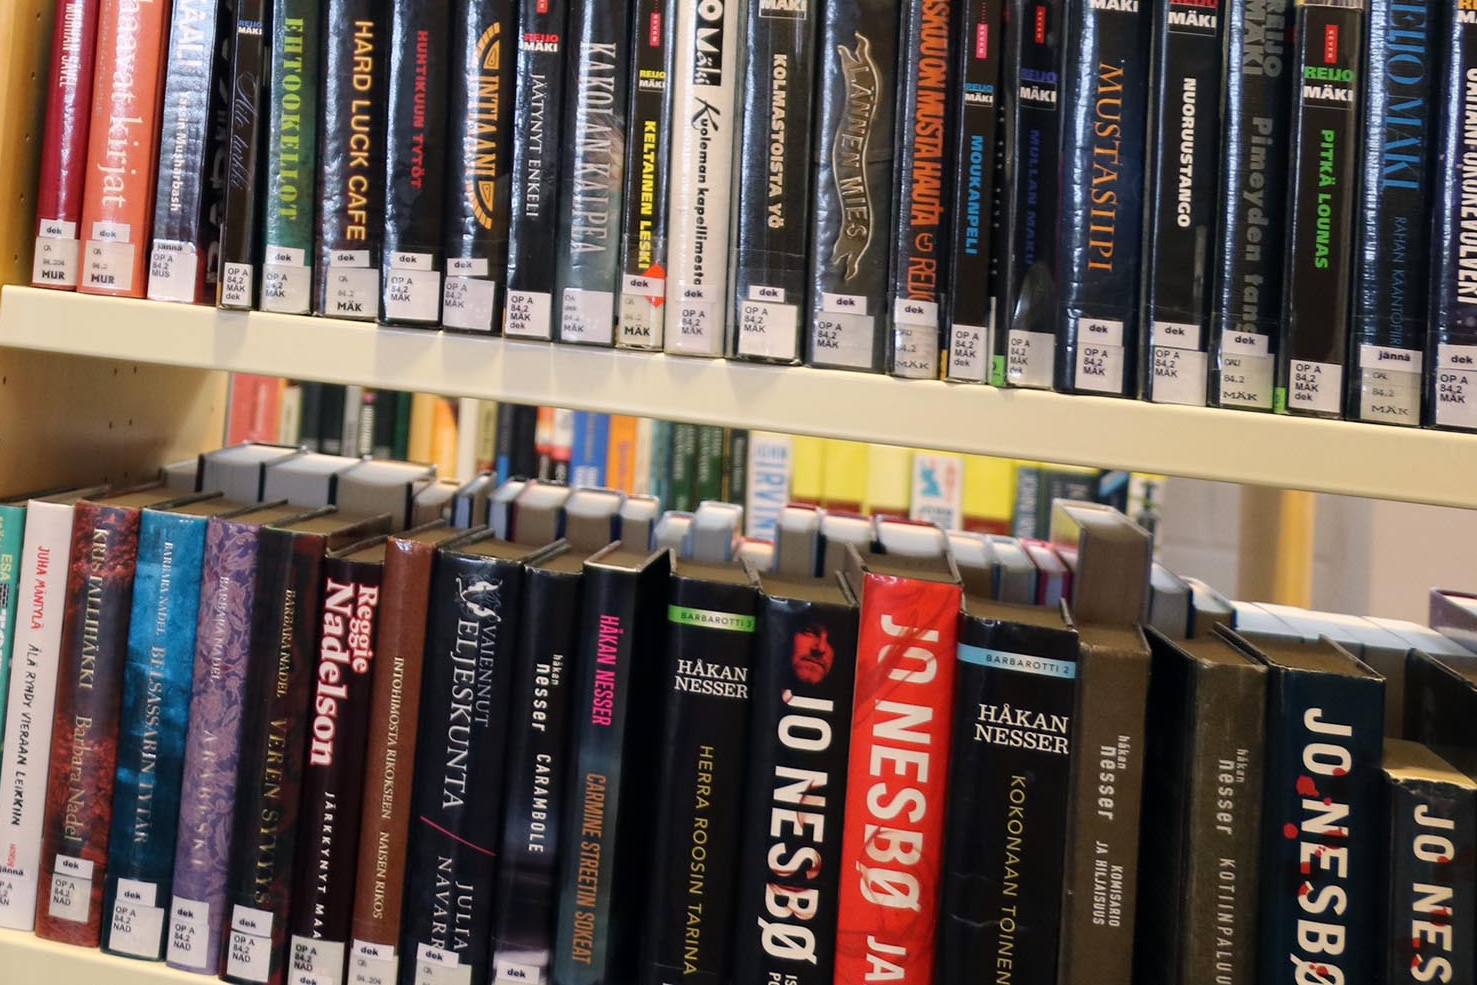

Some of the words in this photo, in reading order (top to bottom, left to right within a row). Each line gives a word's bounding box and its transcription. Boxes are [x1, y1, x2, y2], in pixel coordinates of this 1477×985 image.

[353, 21, 374, 87] HARD
[1303, 66, 1354, 82] REIJO
[278, 17, 305, 222] EHTOOKELLOT
[528, 74, 548, 153] JÄÄTYNYT
[768, 54, 788, 197] KOLMASTOISTA
[1303, 85, 1354, 102] MÄKI
[97, 116, 143, 208] kirjat
[350, 95, 372, 165] LUCK
[1177, 77, 1197, 228] NUORUUSTANGO
[1319, 129, 1335, 186] PITKÄ
[526, 159, 541, 217] ENKELI
[640, 120, 657, 215] KELTAINEN
[966, 135, 983, 255] MOUKANPELI
[1088, 61, 1126, 272] MUSTASIIPI
[346, 172, 369, 241] CAFE
[1315, 194, 1332, 269] LOUNAS
[638, 221, 653, 269] LESKI
[836, 298, 855, 307] dek
[1378, 350, 1410, 362] jännä
[0, 554, 12, 581] ESA
[36, 546, 50, 577] JUHA
[31, 580, 45, 630] MÄNTYLÄ
[78, 528, 110, 690] KRISTALLIHÄKKI
[348, 584, 379, 674] Reggie
[310, 577, 356, 766] Nadelson
[552, 654, 563, 685] håkan
[597, 615, 623, 665] HÅKAN
[677, 658, 748, 682] HÅKAN
[874, 613, 940, 684] JO
[475, 625, 497, 728] VAIENNUT
[532, 663, 551, 732] nesser
[592, 669, 616, 726] NESSER
[674, 677, 748, 699] NESSER
[17, 713, 32, 765] VIERAAN
[69, 715, 93, 782] Barbara
[776, 689, 834, 752] JO
[974, 723, 1069, 755] NESSER
[978, 703, 1069, 733] HÅKAN
[1301, 707, 1354, 776] JO
[11, 772, 26, 826] LEIKKIIN
[528, 753, 551, 853] CARAMBOLE
[583, 772, 606, 838] CARMINE
[696, 745, 714, 809] HERRA
[855, 699, 935, 913] NESBØ
[1097, 745, 1117, 821] nesser
[1216, 759, 1235, 835] nesser
[64, 787, 85, 842] Nadel
[316, 792, 336, 894] JÄRKKYNYT
[1002, 775, 1027, 896] KOKONAAN
[576, 841, 601, 907] STREETIN
[691, 816, 709, 895] ROOSIN
[757, 765, 829, 965] NESBØ
[453, 881, 473, 949] JULIA
[1092, 858, 1106, 925] HILJAISUUS
[572, 911, 595, 965] SOKEAT
[683, 901, 704, 975] TARINA
